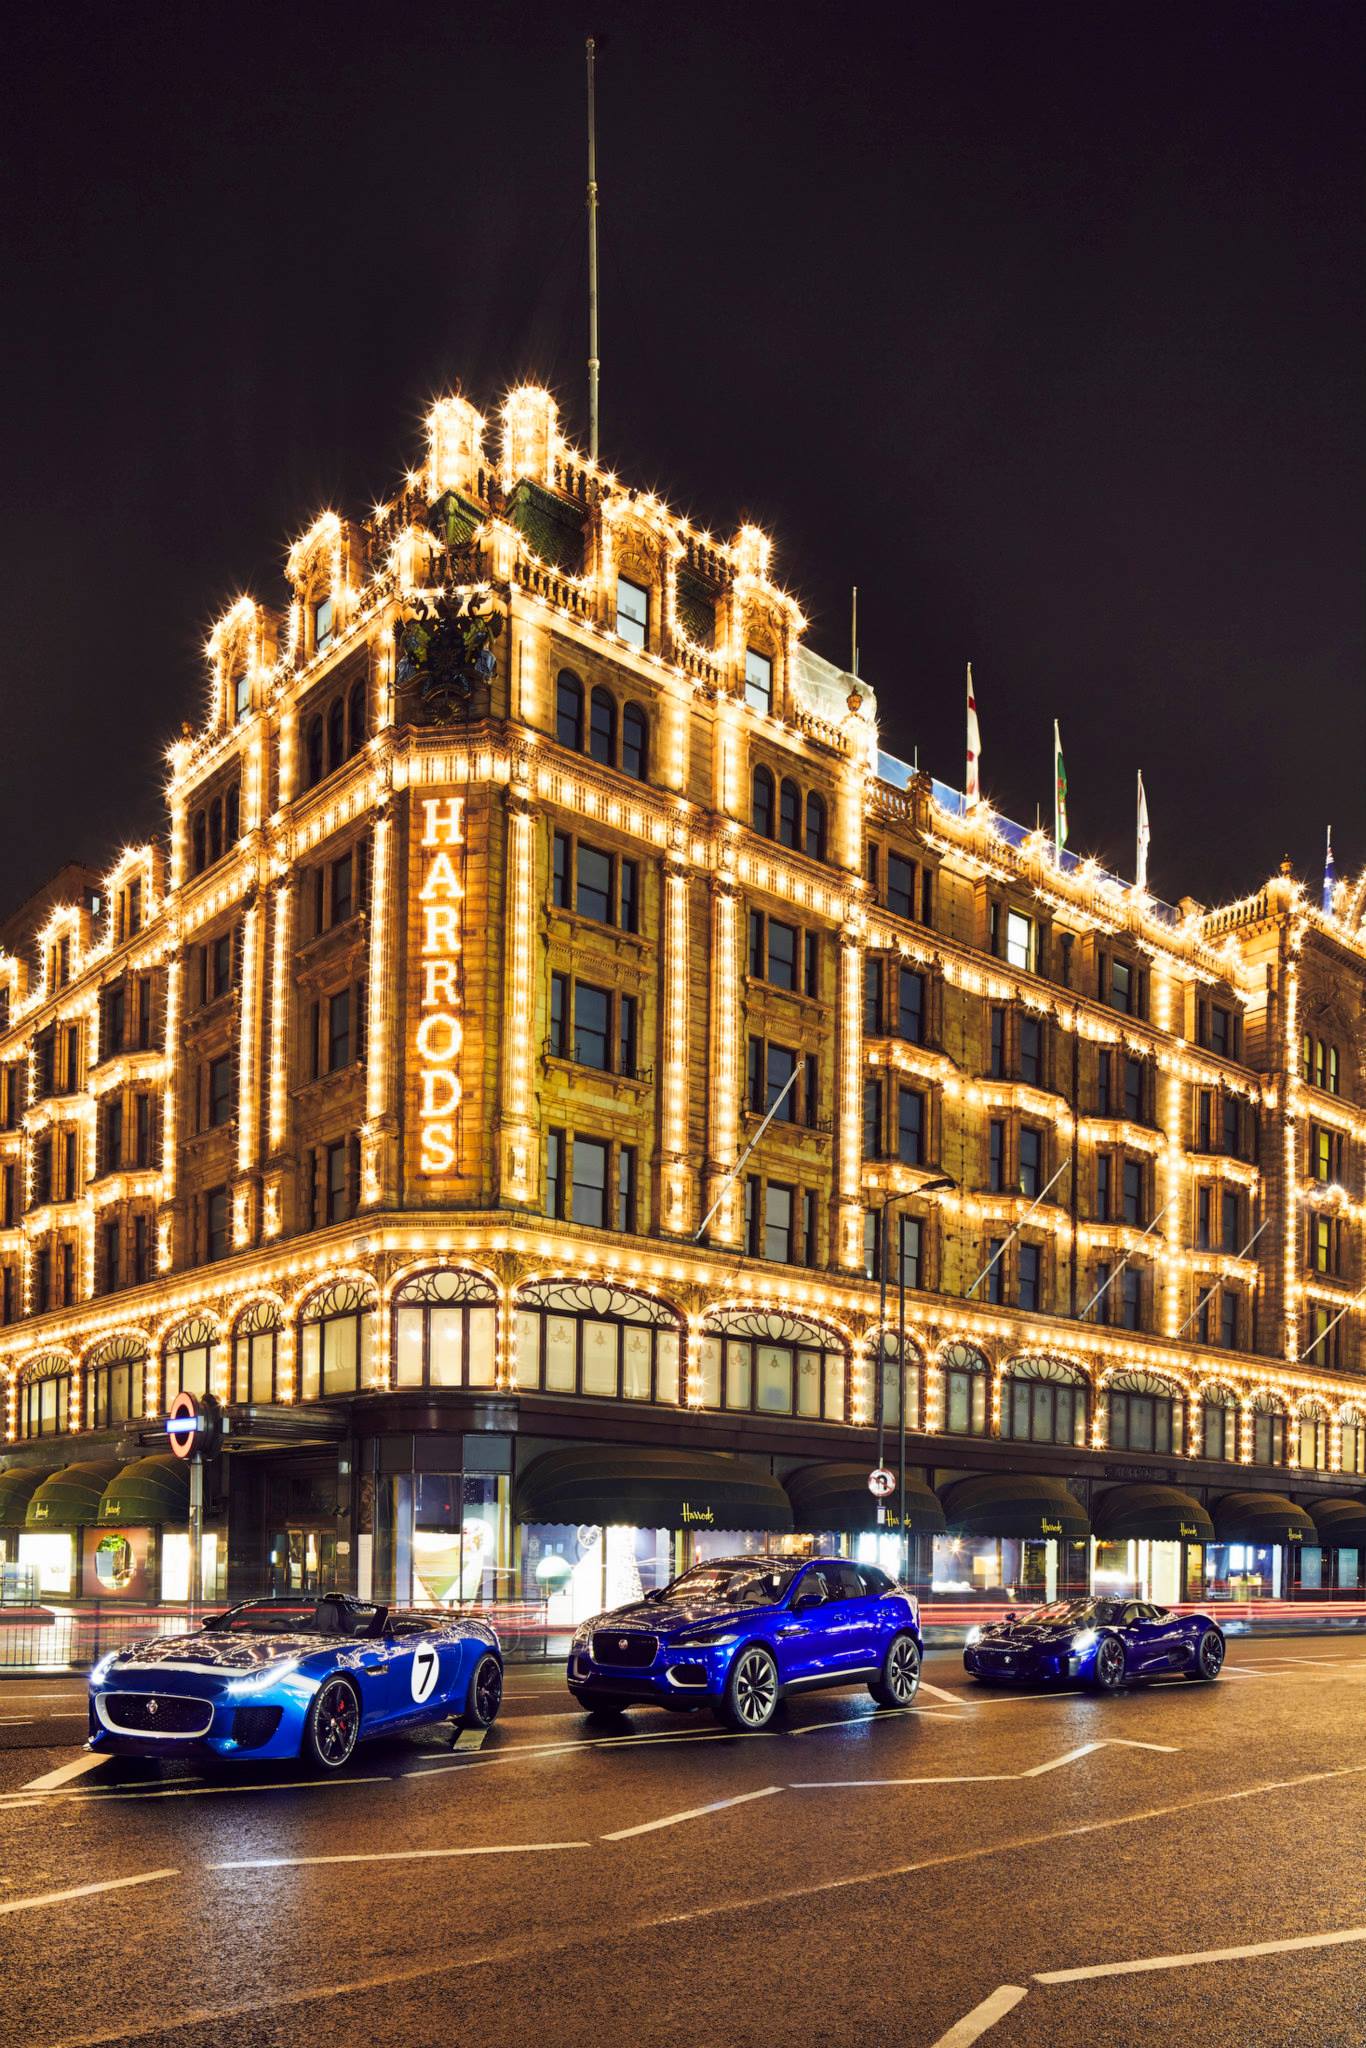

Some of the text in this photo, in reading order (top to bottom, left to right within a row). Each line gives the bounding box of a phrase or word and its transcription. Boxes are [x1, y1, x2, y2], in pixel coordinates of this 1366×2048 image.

[415, 797, 466, 1173] HARRODS
[680, 1502, 714, 1524] Harrods
[886, 1509, 912, 1528] Hards
[418, 1653, 434, 1696] 7
